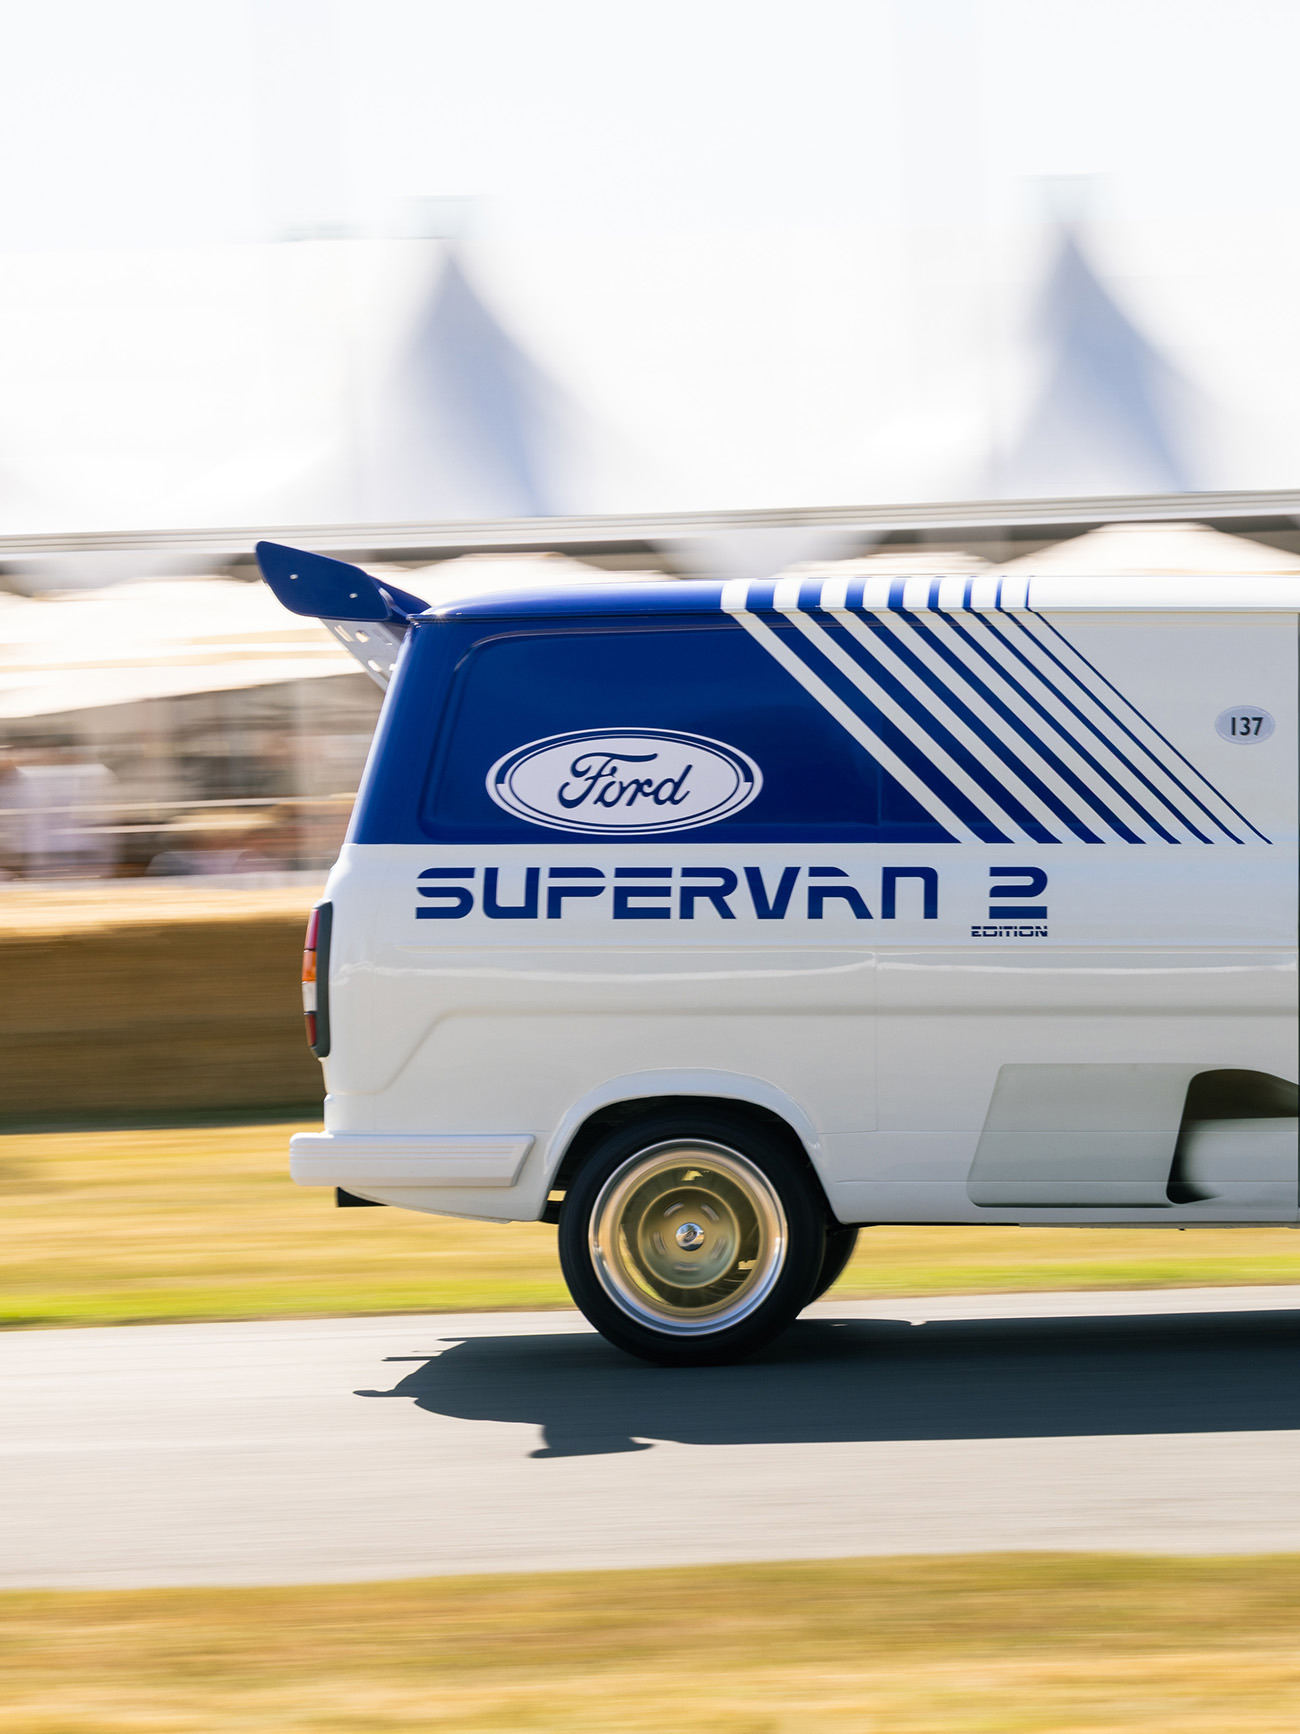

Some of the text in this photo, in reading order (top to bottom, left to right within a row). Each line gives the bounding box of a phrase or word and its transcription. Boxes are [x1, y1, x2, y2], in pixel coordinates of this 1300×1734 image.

[1231, 716, 1264, 736] 137
[557, 751, 693, 808] Ford
[415, 866, 1048, 920] SUPERVAN 2
[971, 925, 1048, 937] EDITION
